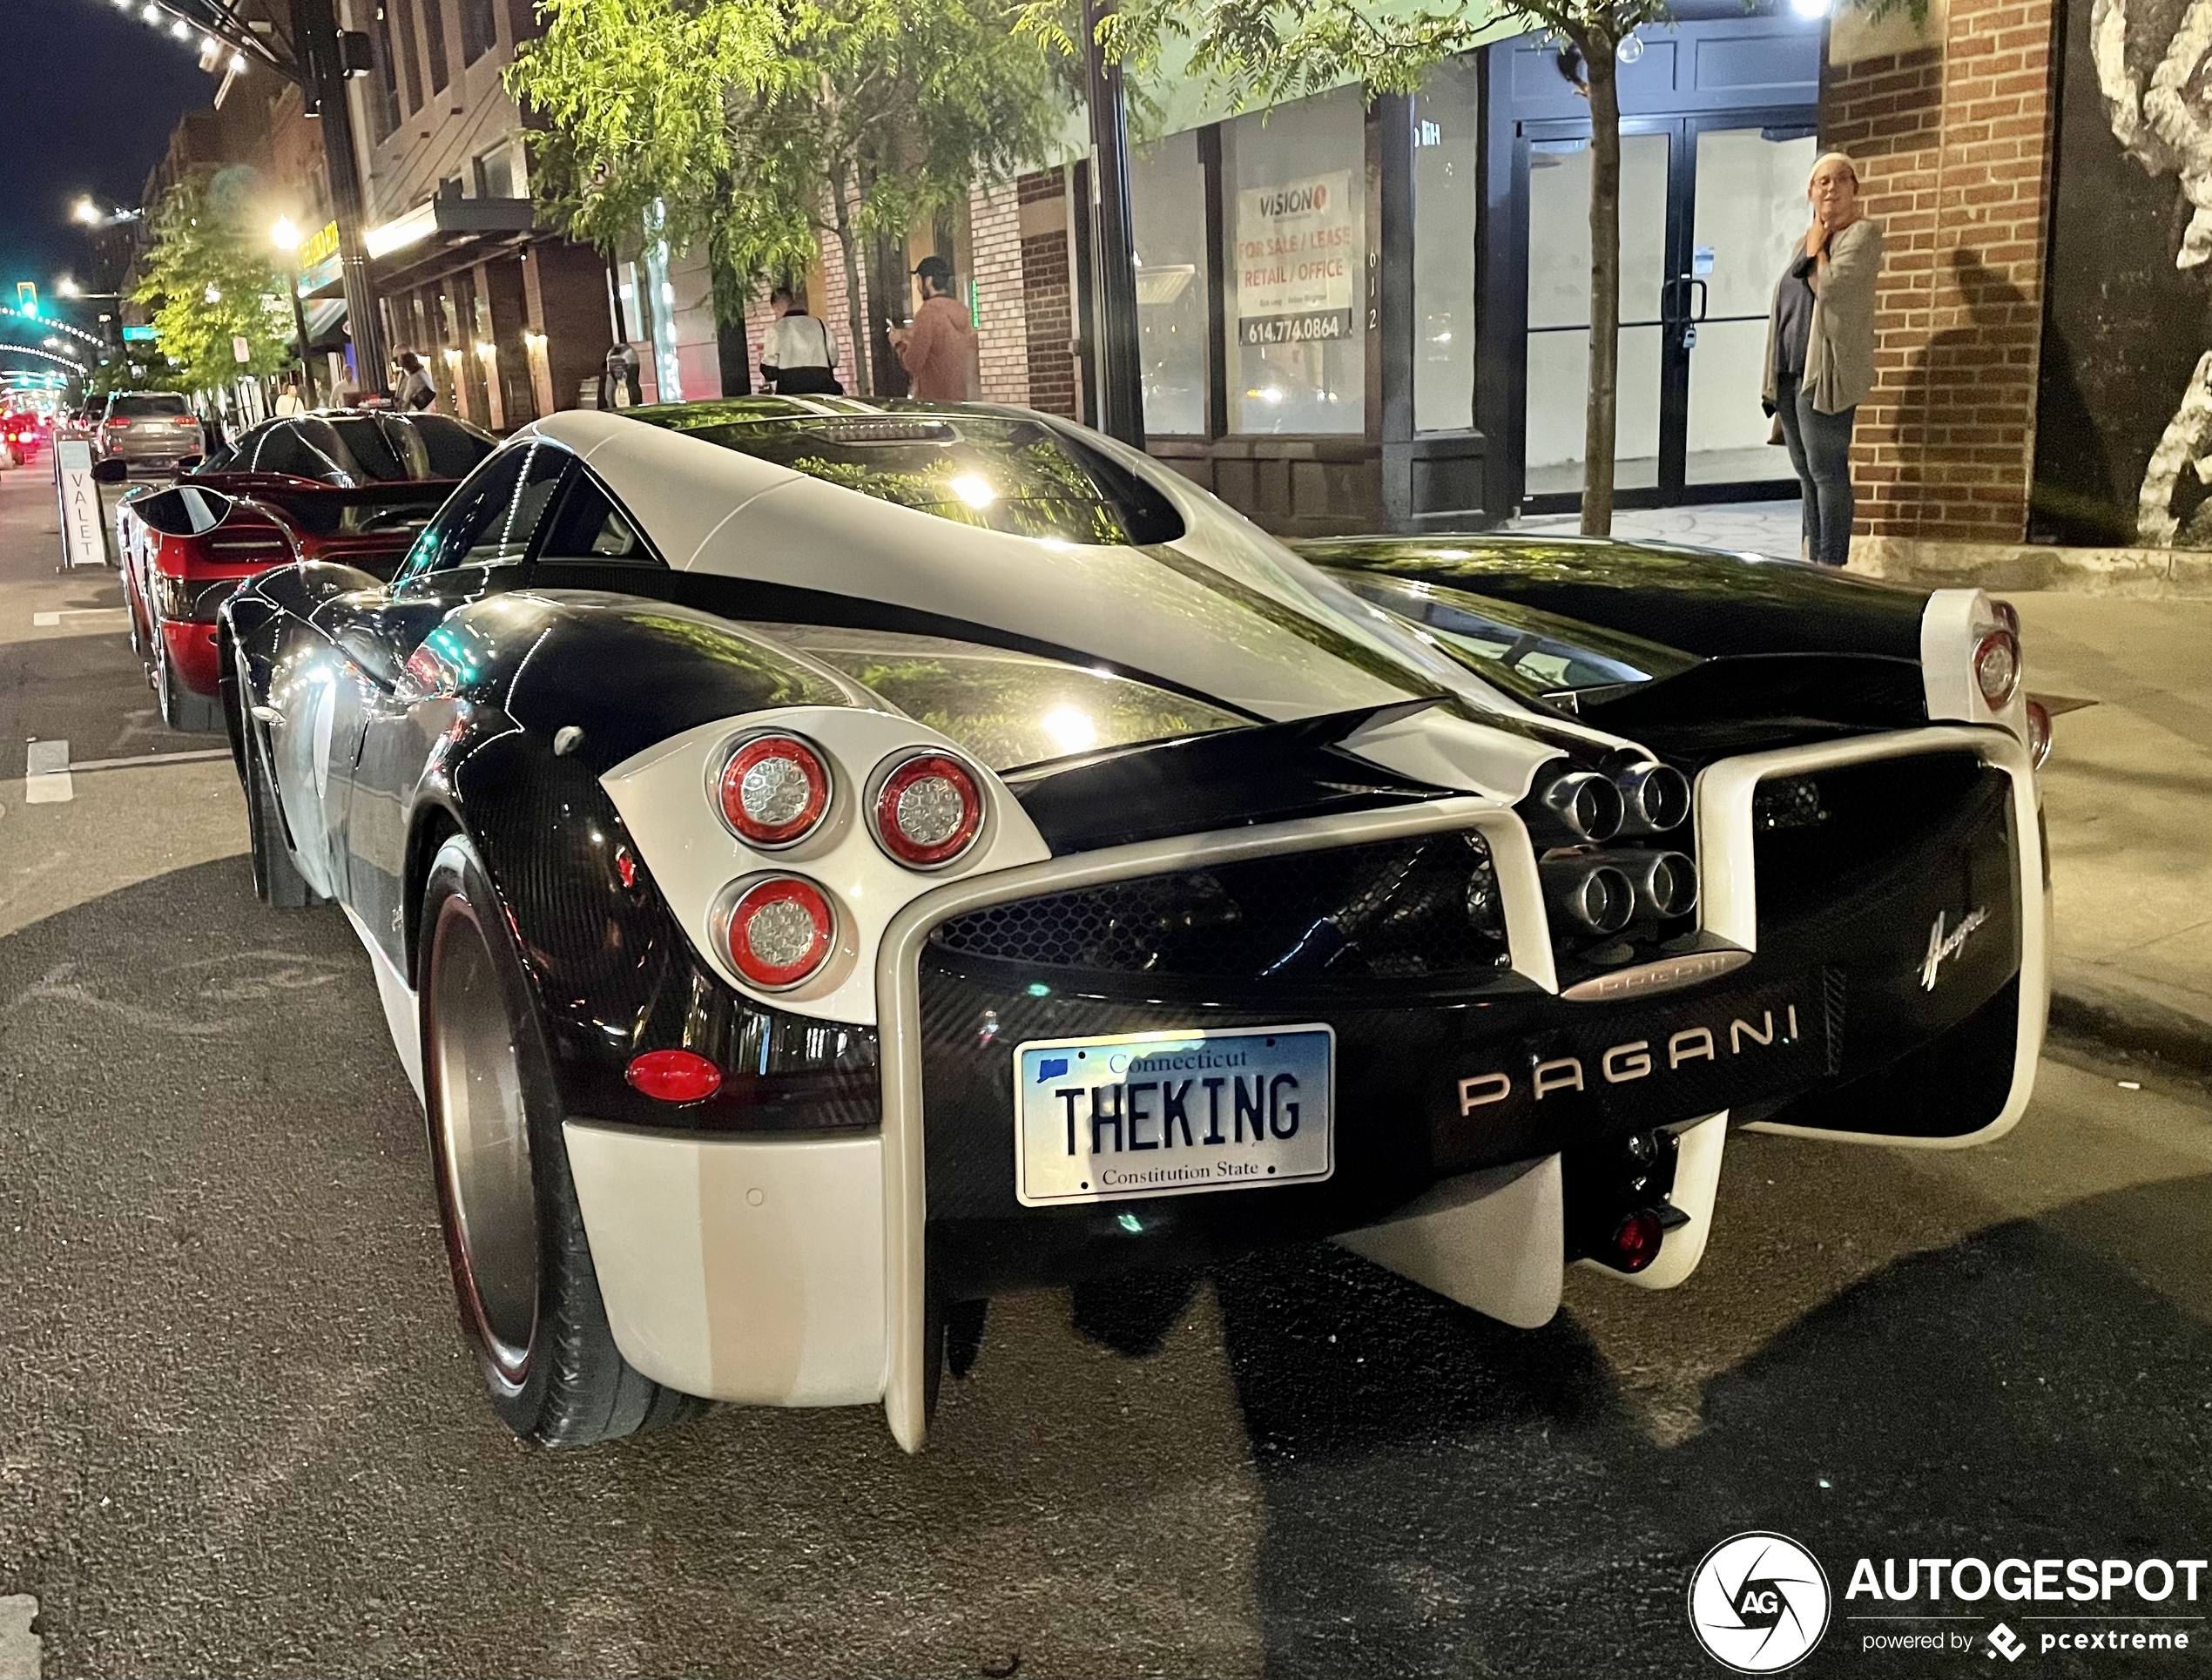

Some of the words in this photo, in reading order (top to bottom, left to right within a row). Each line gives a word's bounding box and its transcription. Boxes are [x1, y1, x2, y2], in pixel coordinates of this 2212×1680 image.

[1238, 241, 1263, 260] FOR
[1267, 235, 1297, 255] SALE
[1310, 226, 1351, 249] LEASE
[1244, 266, 1286, 287] RETAIL
[1298, 258, 1344, 281] OFFICE
[1249, 316, 1339, 343] 614.774.0864
[71, 473, 92, 556] VALET
[1109, 1049, 1247, 1075] Connecticut
[1458, 1004, 1797, 1117] PAGANI
[1055, 1073, 1300, 1156] THEKING
[1102, 1164, 1211, 1186] Constitution
[1216, 1160, 1259, 1177] State
